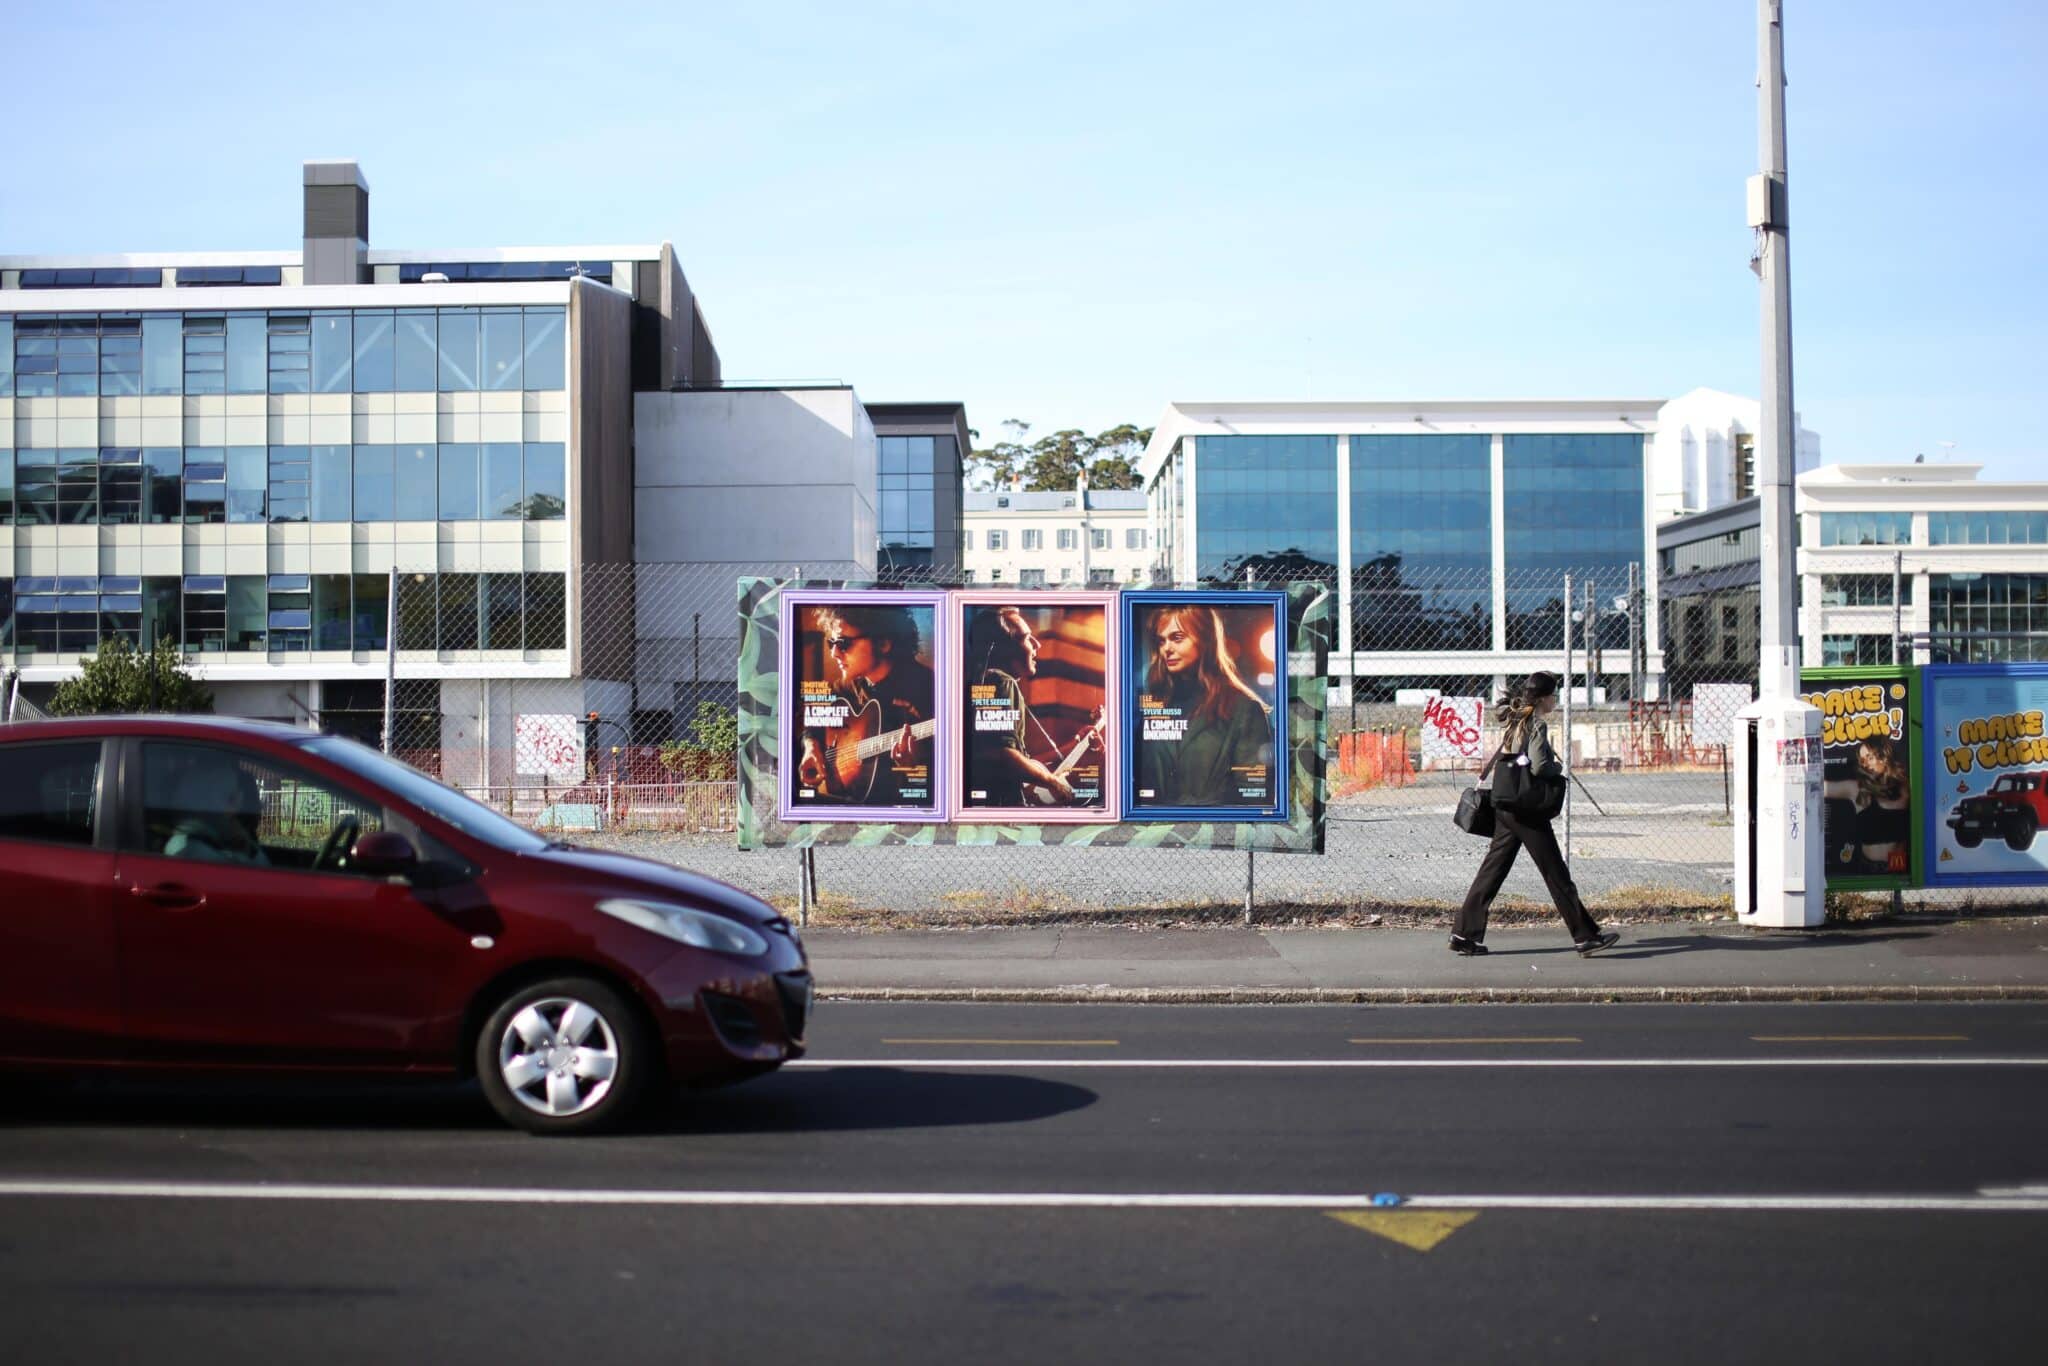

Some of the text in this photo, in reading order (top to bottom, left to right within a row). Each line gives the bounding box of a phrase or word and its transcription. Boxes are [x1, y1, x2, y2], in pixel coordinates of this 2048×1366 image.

[804, 706, 849, 716] A COMPLETE
[975, 710, 1020, 720] A COMPLETE
[804, 717, 843, 727] UNKNOWN
[975, 720, 1014, 731] UNKNOWN
[1143, 720, 1188, 730] A COMPLETE
[1959, 711, 2043, 746] MAKE
[1143, 730, 1182, 740] UNKNOWN
